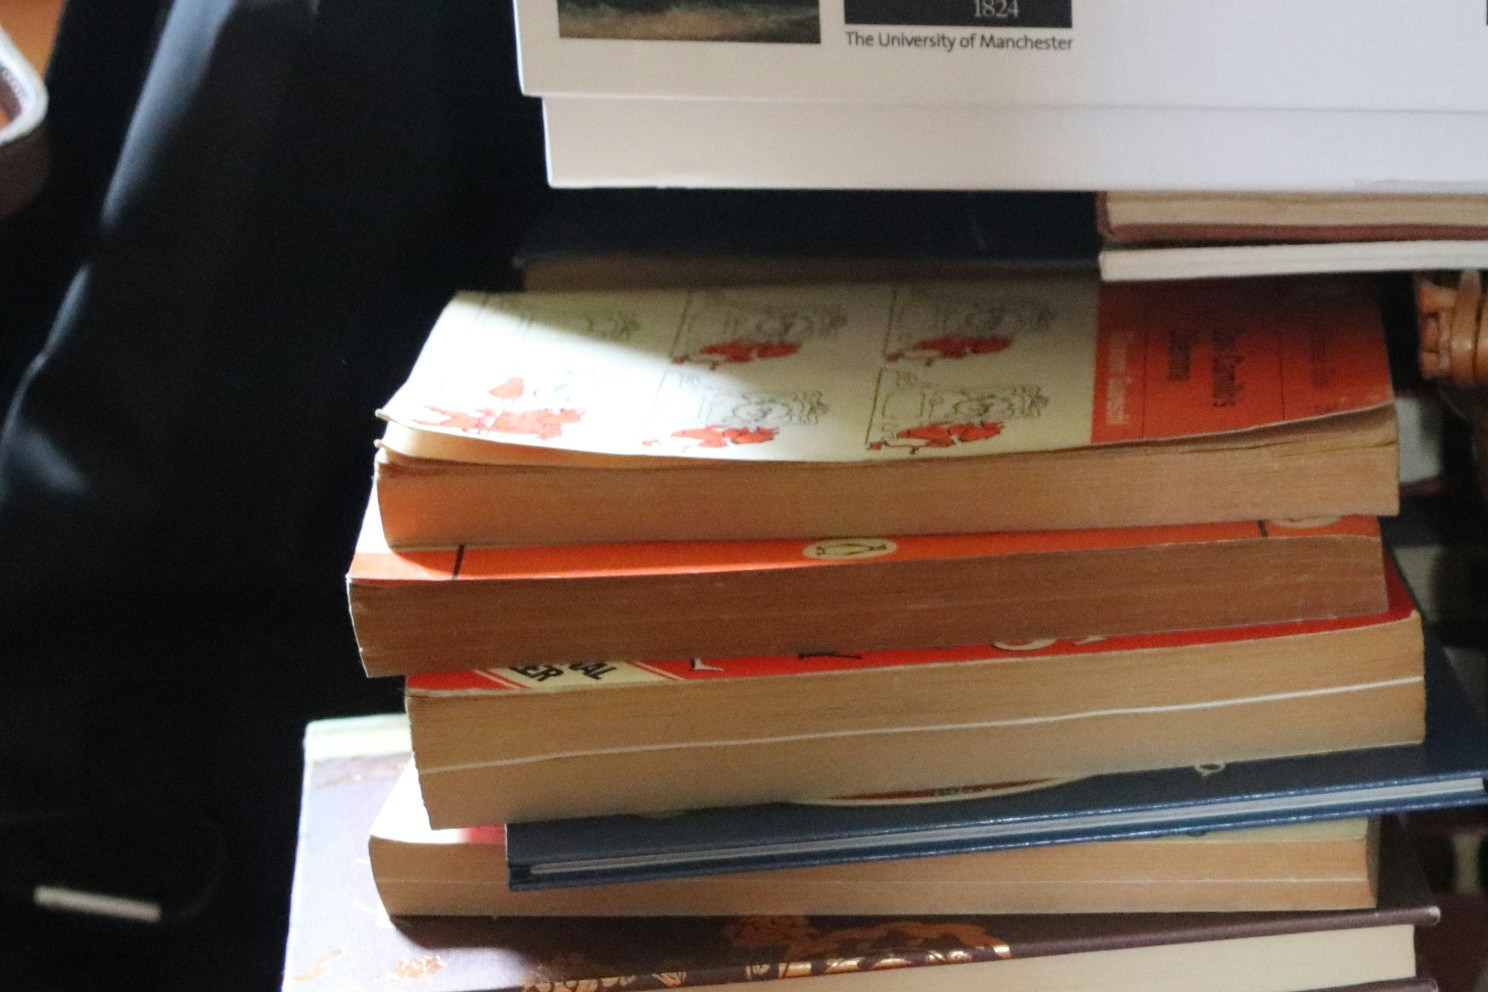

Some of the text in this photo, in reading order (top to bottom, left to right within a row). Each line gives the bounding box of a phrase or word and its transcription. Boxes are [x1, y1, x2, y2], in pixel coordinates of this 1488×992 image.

[973, 0, 1020, 18] 1824
[845, 31, 1074, 52] The University of Manchester
